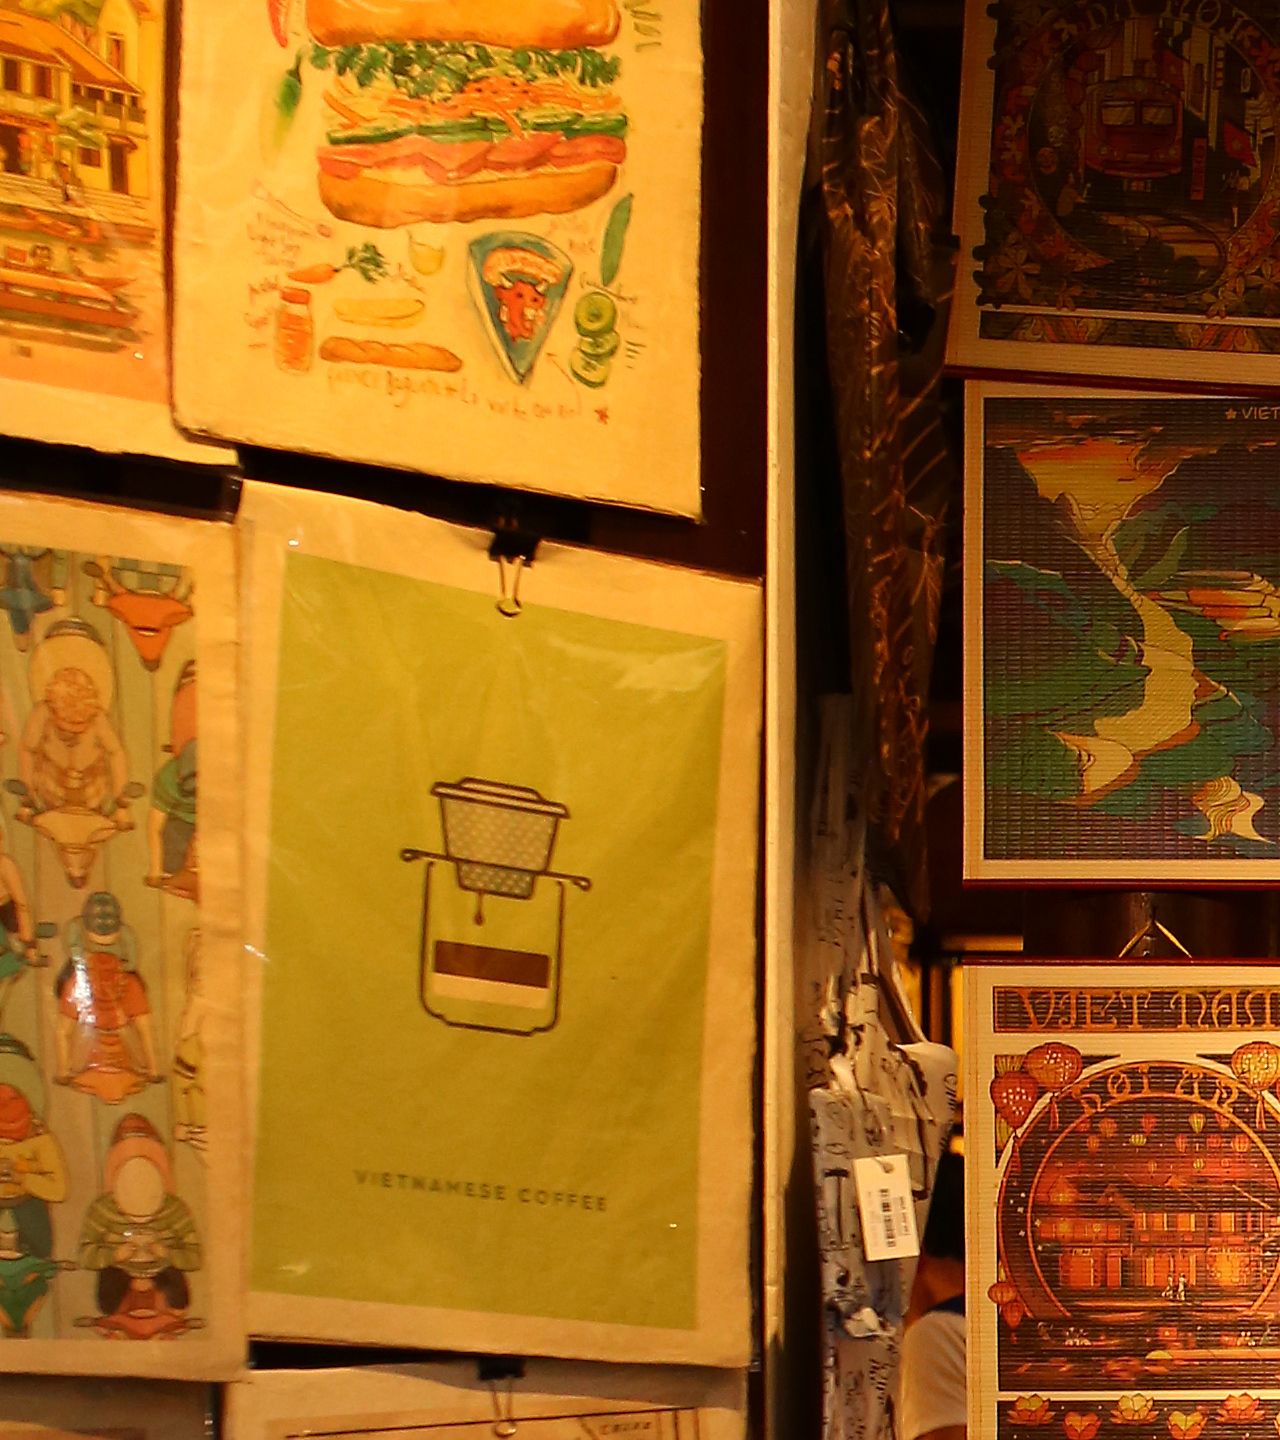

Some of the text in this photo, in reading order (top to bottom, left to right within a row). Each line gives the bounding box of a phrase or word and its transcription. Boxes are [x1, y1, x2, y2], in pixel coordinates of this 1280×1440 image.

[1017, 987, 1153, 1031] VIET
[353, 1169, 608, 1212] VIETNAMESE COFFEE
